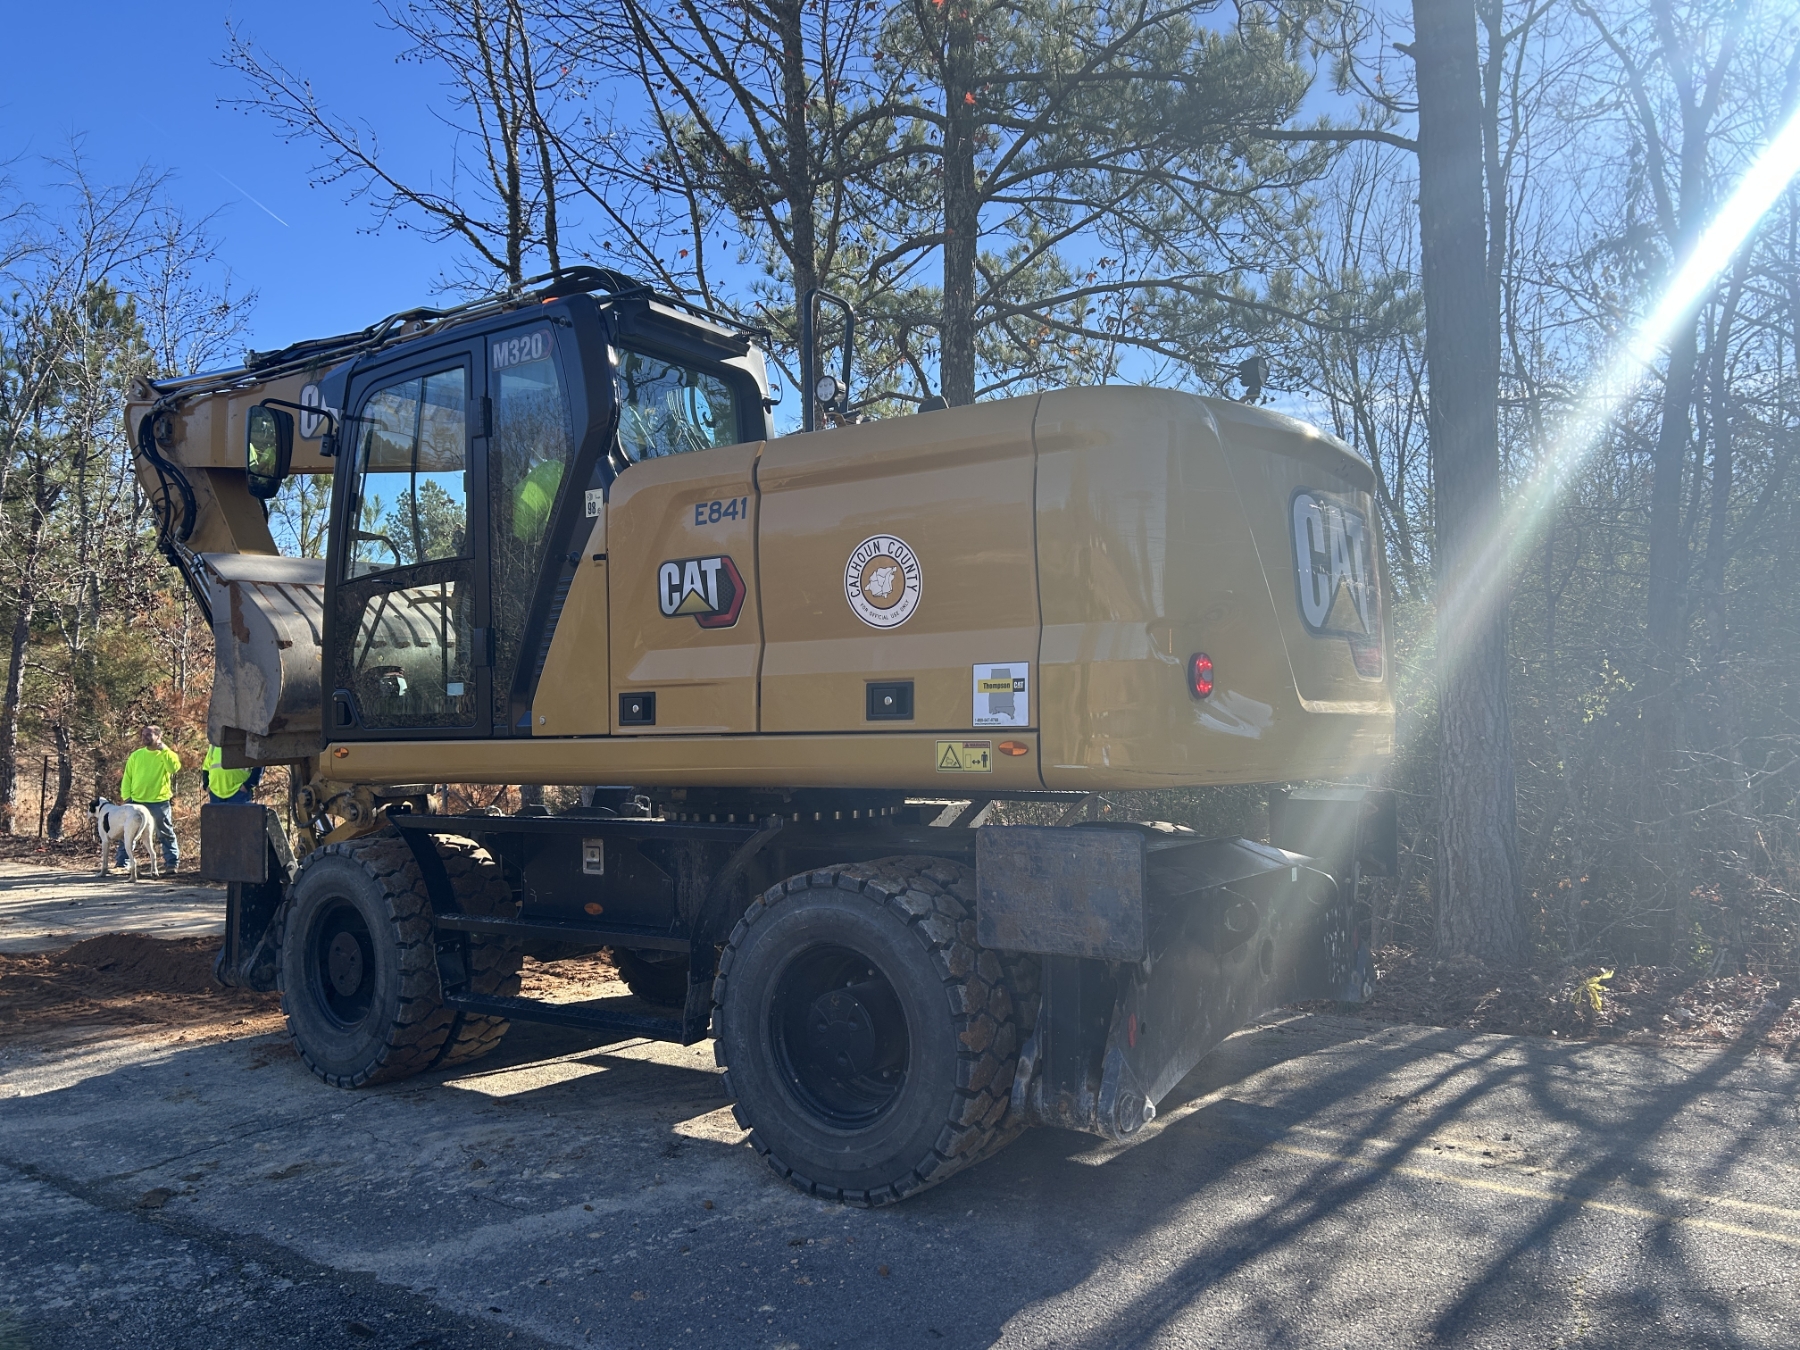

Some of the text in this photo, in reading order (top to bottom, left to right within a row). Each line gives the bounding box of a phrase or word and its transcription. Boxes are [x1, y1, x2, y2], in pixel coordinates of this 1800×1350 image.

[493, 333, 542, 369] M320
[695, 497, 748, 526] E841
[848, 540, 918, 598] CALHOUN COUNTY
[1293, 494, 1370, 635] CAT
[660, 557, 722, 615] CAT
[860, 602, 869, 613] FOR
[869, 611, 889, 620] OFFICIAL
[900, 599, 910, 612] ONLY
[982, 681, 1024, 690] Thompson CAT
